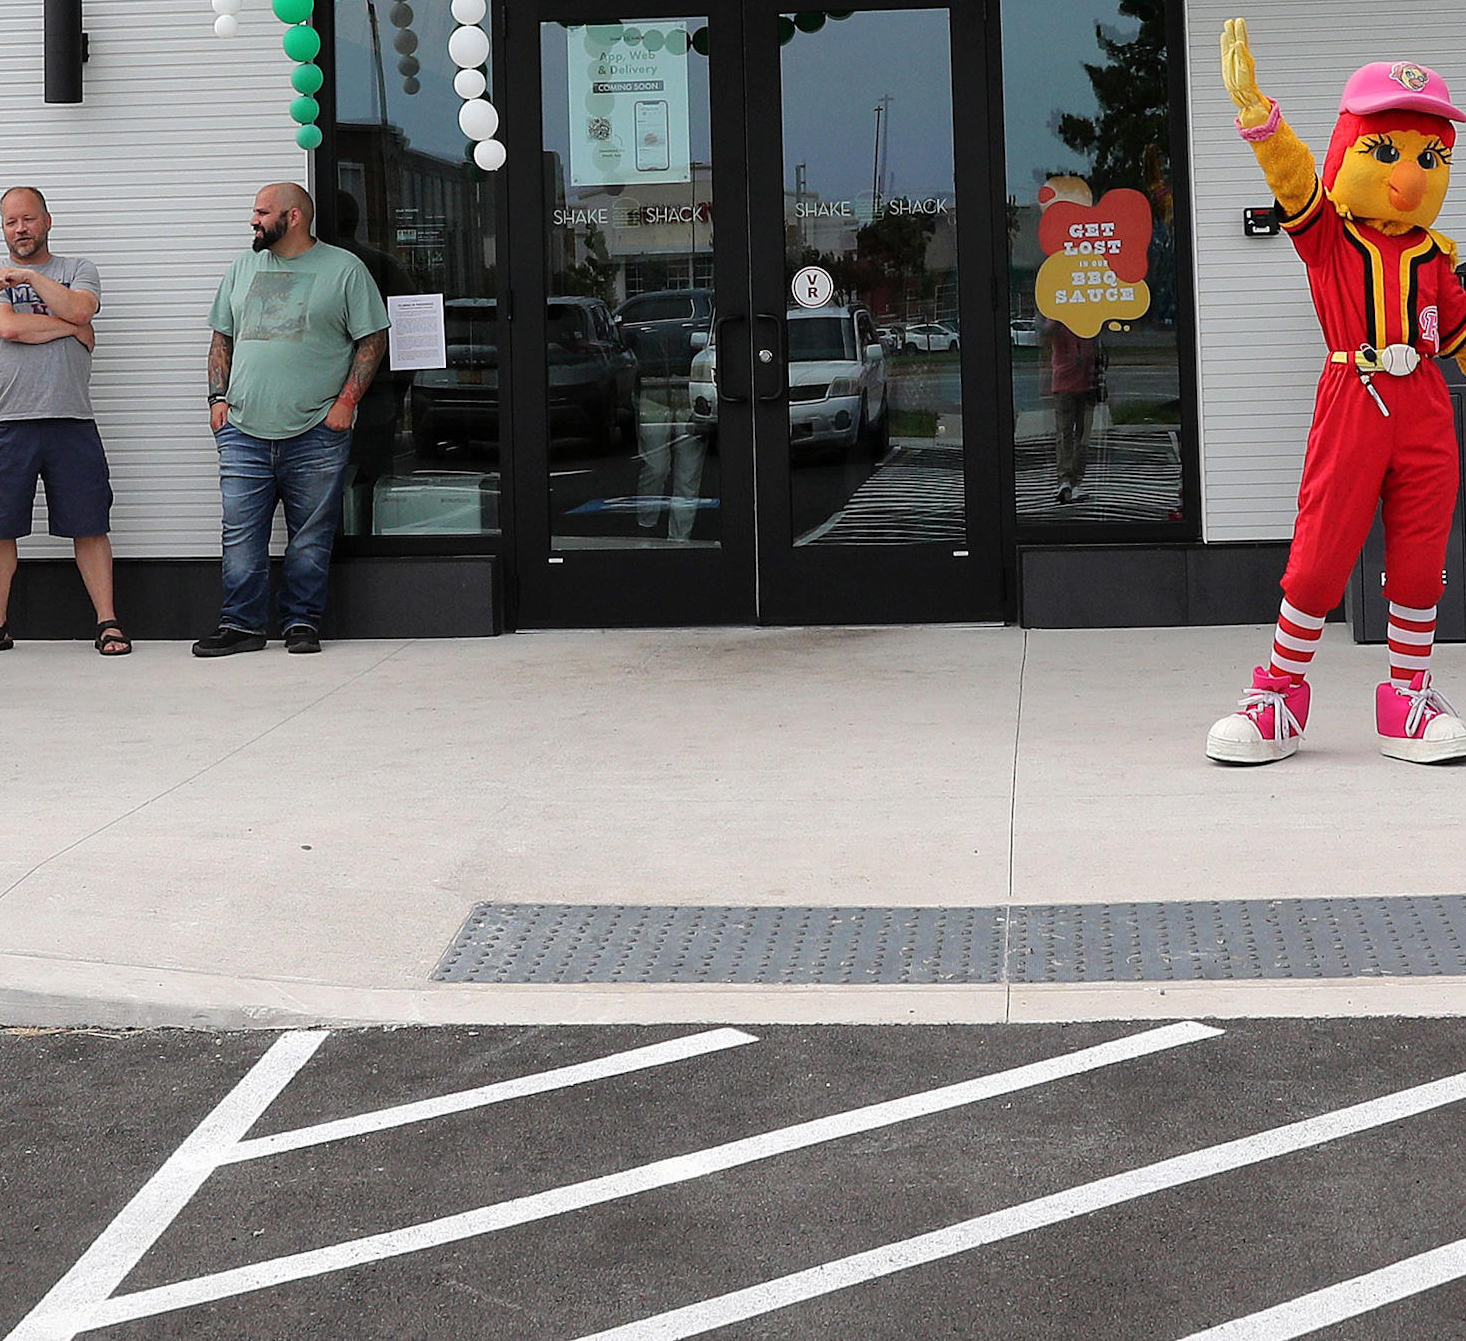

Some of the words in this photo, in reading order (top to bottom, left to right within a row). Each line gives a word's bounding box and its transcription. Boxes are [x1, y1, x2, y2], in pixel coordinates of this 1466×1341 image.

[600, 52, 626, 63] App,
[630, 49, 656, 60] Web
[598, 66, 606, 74] &
[610, 64, 658, 76] Delivery
[598, 83, 632, 92] COMING
[634, 82, 659, 91] SOON
[795, 201, 852, 218] SHAKE
[889, 198, 948, 215] SHACK
[553, 209, 608, 225] SHAKE
[646, 207, 704, 223] SHACK
[1069, 222, 1115, 238] GET
[1063, 240, 1122, 255] LOST
[806, 274, 818, 285] V
[1071, 270, 1118, 287] BBQ
[808, 288, 818, 298] R
[1055, 287, 1135, 304] SAUCE
